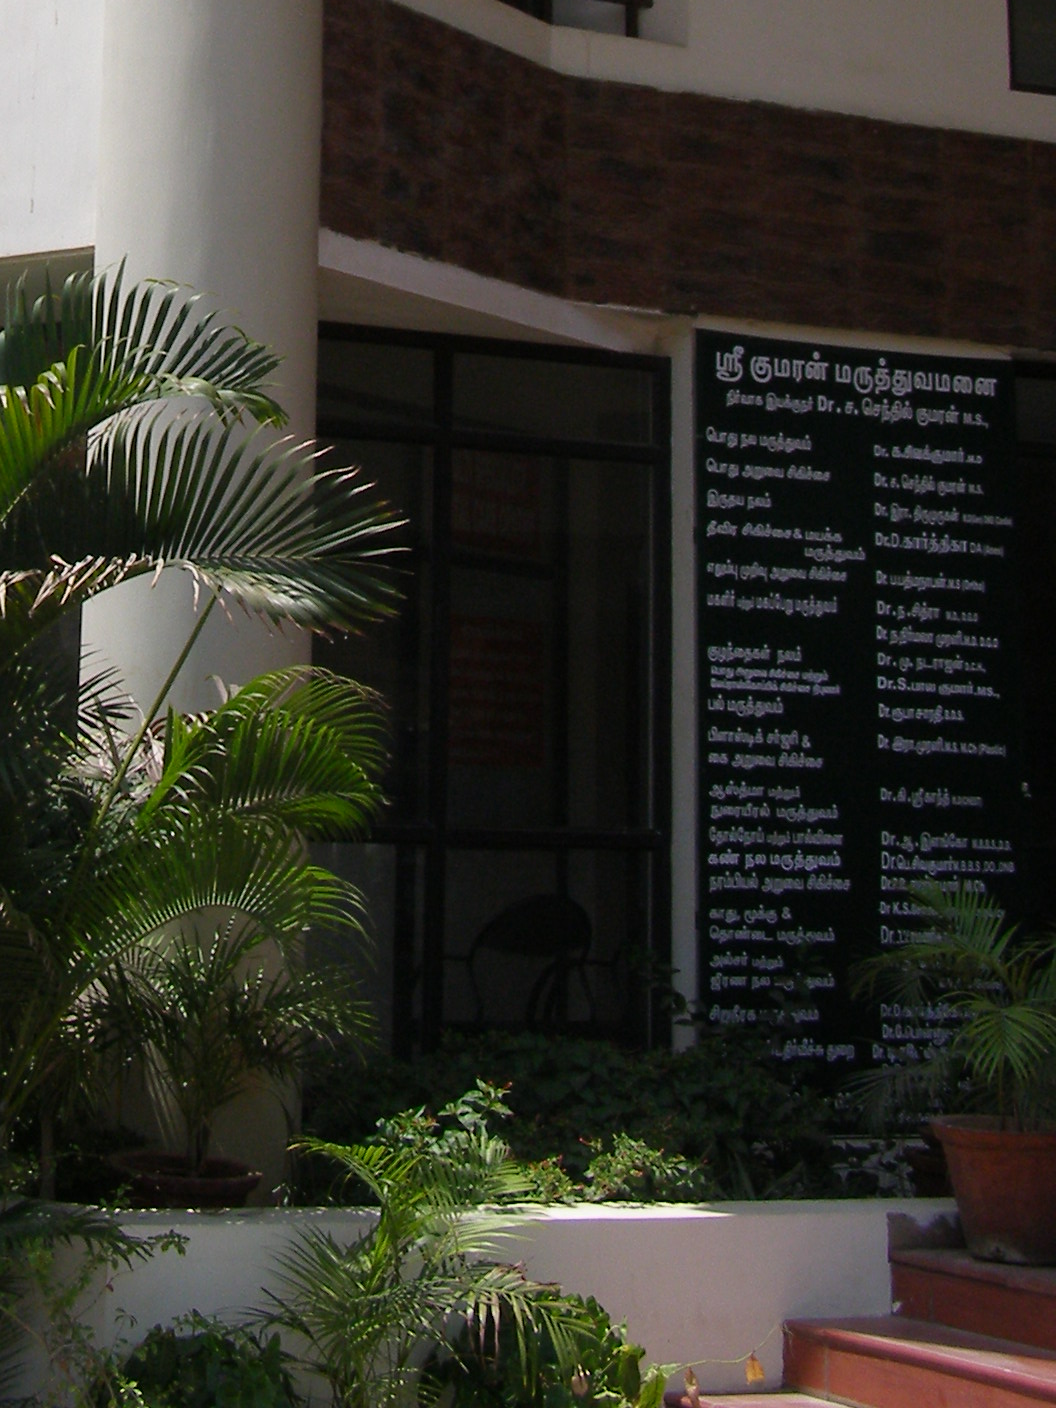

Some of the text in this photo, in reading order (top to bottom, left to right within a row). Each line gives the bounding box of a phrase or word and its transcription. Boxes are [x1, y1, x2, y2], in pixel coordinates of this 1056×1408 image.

[716, 345, 998, 397] ஸ்ரீ குமரன் மருத்துவமனை
[708, 848, 740, 865] கண்
[769, 849, 842, 871] மருத்துவம்
